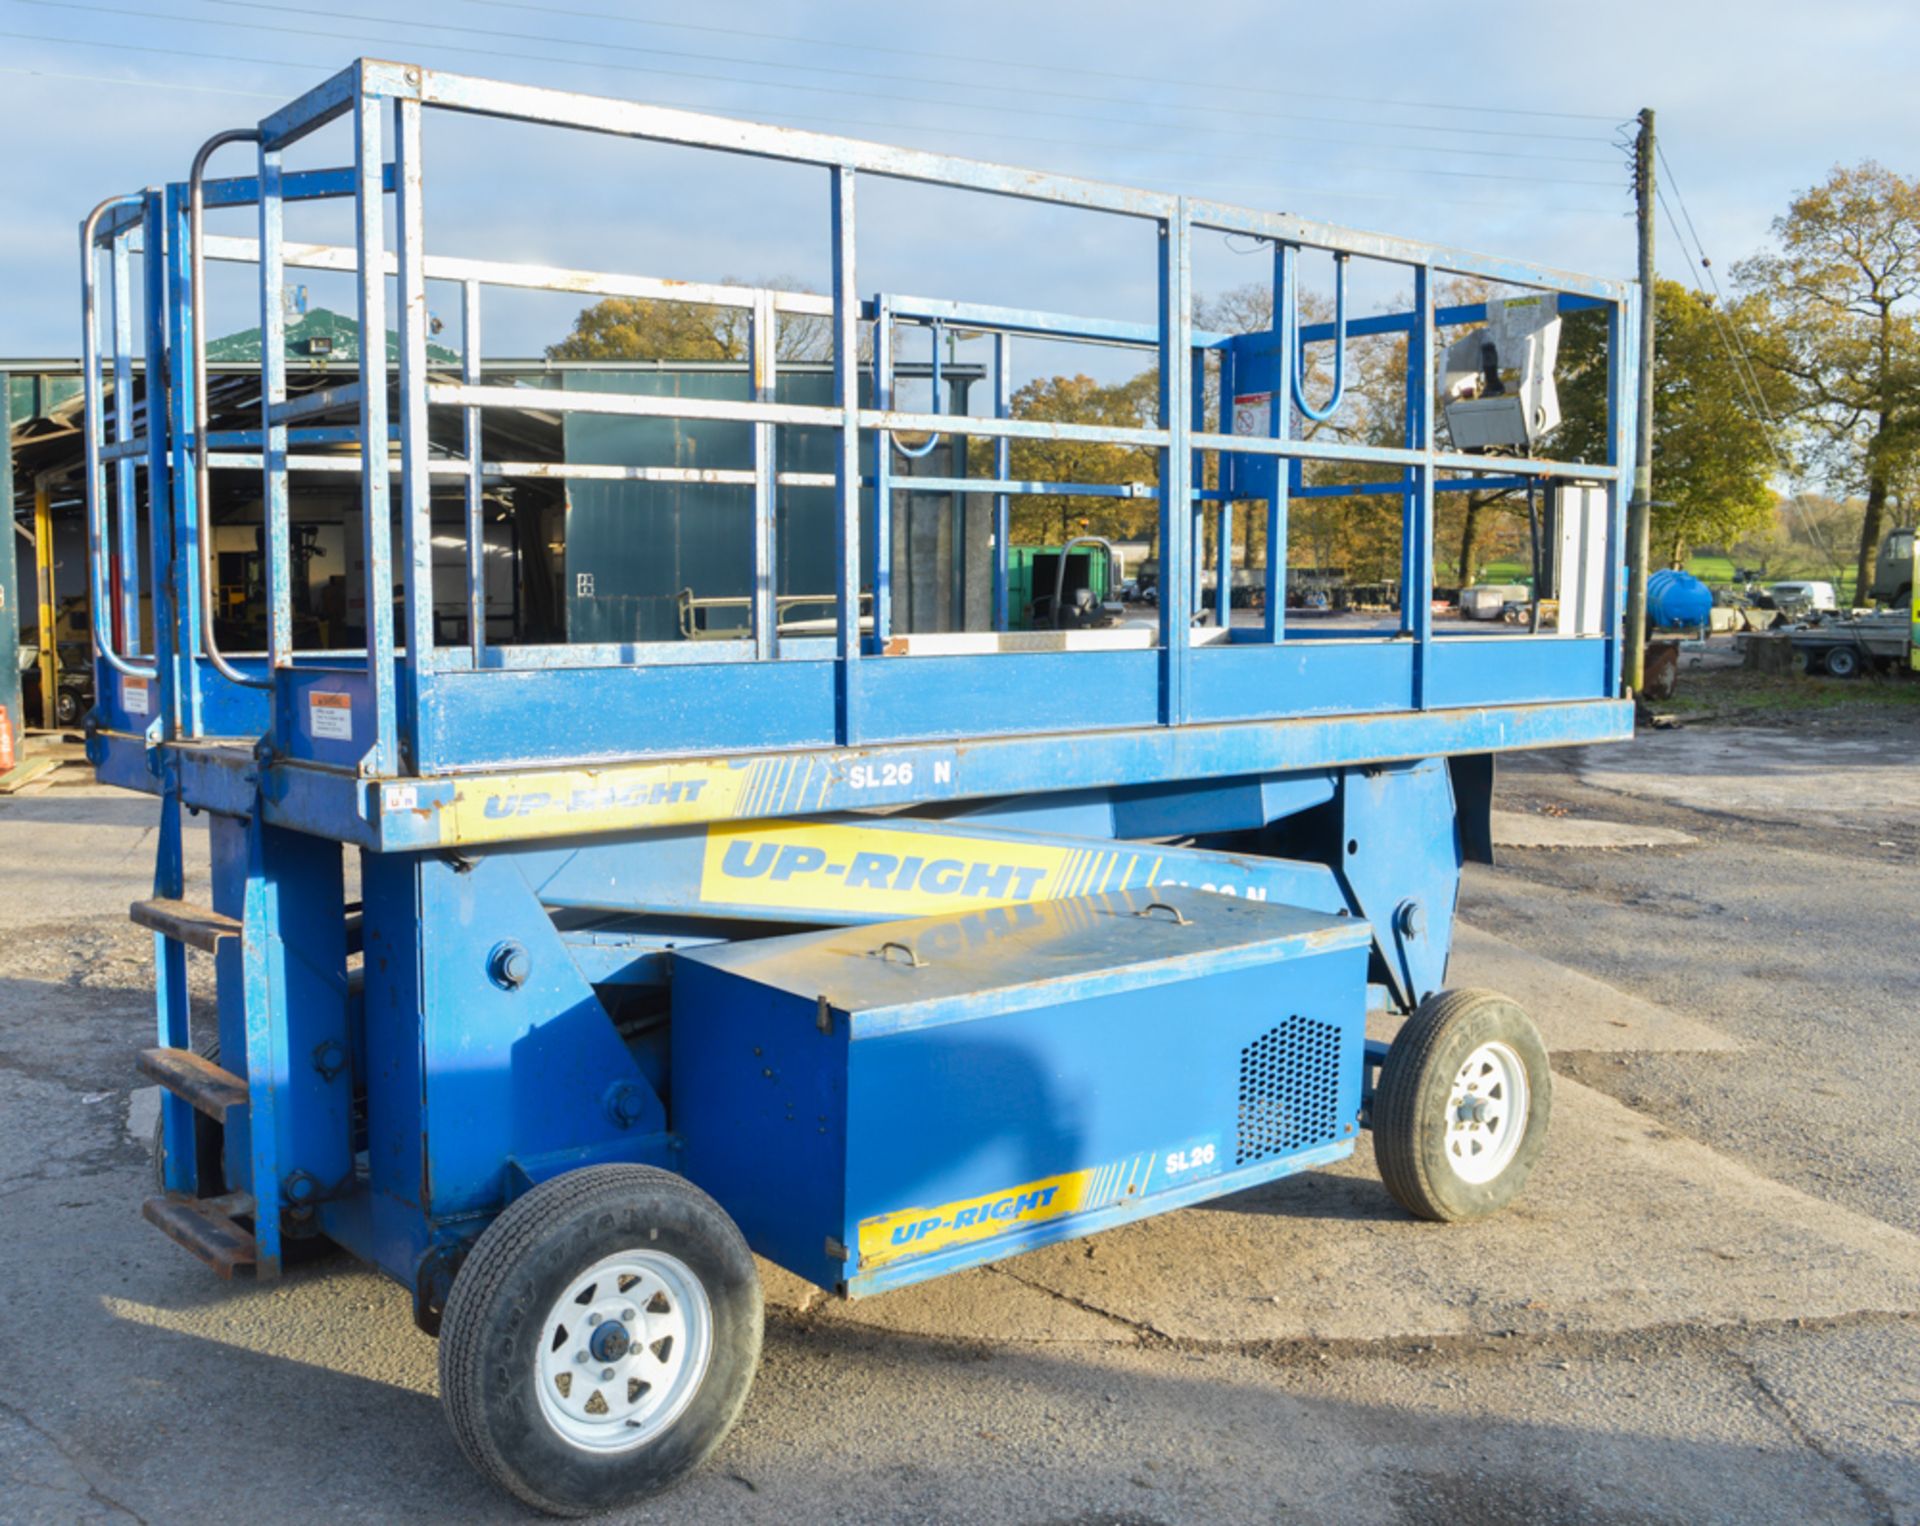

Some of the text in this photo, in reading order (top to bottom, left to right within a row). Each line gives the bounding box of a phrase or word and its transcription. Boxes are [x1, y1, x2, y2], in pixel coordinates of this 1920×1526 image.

[849, 760, 951, 789] SL26 N
[483, 778, 708, 820] UP-RIGHT
[720, 839, 1048, 901] UP-RIGHT
[1165, 1143, 1216, 1175] SL26
[890, 1185, 1060, 1246] UP-RIGHT
